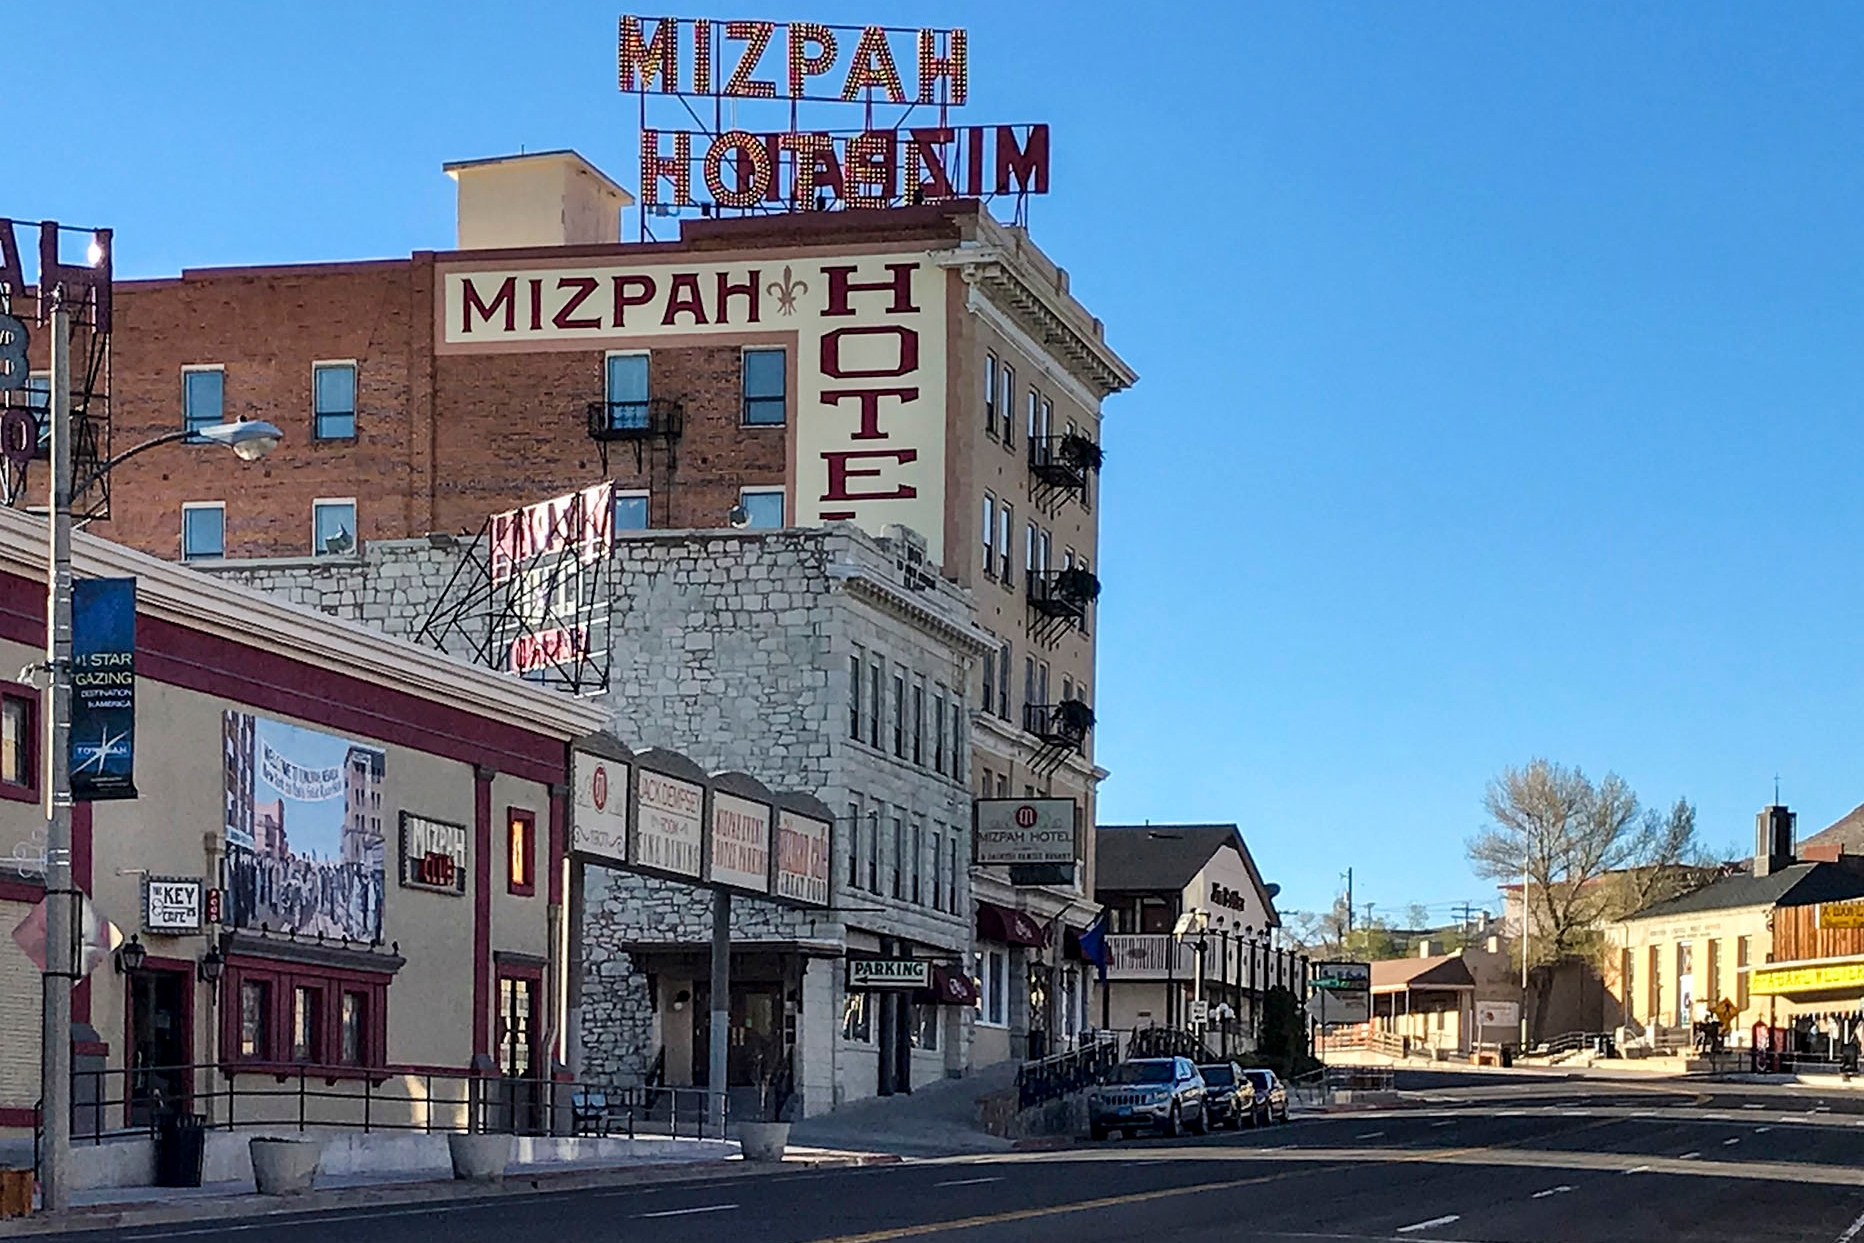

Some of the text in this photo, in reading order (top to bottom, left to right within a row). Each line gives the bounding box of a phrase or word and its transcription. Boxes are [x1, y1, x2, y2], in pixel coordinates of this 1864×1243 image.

[618, 14, 968, 106] MIZPAH
[642, 128, 940, 211] HOTEL
[462, 270, 762, 332] MIZPAH
[819, 263, 921, 520] HOTE
[91, 653, 132, 666] STAR
[75, 672, 132, 685] GAZING
[979, 831, 1073, 843] MIZPAH HOTEL
[164, 886, 195, 905] KEY
[855, 962, 923, 976] PARKING
